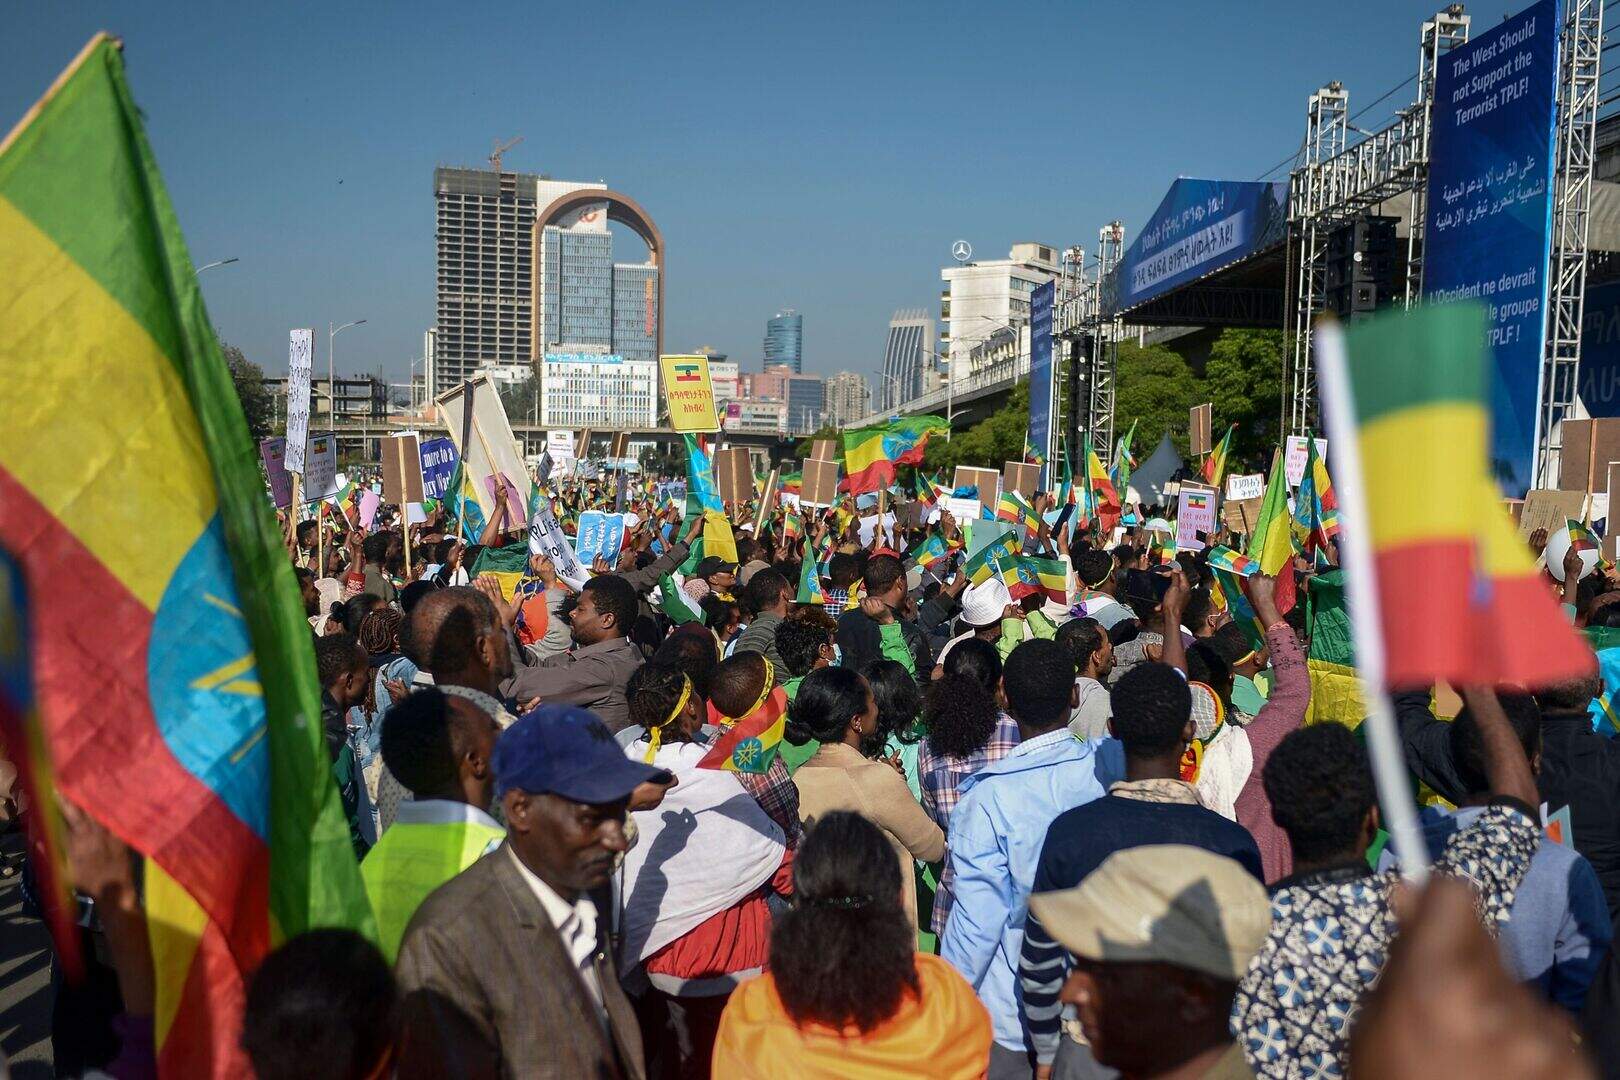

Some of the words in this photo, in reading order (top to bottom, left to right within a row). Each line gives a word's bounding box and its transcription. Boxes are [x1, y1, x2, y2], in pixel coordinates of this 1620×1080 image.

[1453, 59, 1470, 78] The
[1472, 42, 1497, 67] West
[1499, 17, 1536, 54] Should
[1453, 82, 1470, 103] not
[1472, 60, 1512, 94] Support
[1514, 51, 1532, 72] the
[1456, 93, 1498, 126] Terrorist
[1500, 76, 1529, 105] TPLF!
[1496, 160, 1518, 185] الغرب
[1519, 155, 1535, 180] على
[1443, 182, 1465, 205] الجبهة
[1466, 177, 1484, 199] يدعم
[1516, 178, 1545, 204] الشعبية
[1490, 188, 1515, 215] لتحرير
[1429, 281, 1481, 306] L'Occident
[1482, 281, 1496, 296] ne
[1498, 266, 1537, 292] devrait
[1488, 303, 1498, 320] le
[1500, 298, 1539, 322] groupe
[1487, 325, 1513, 347] TPLF
[440, 446, 448, 463] to
[448, 447, 454, 461] a
